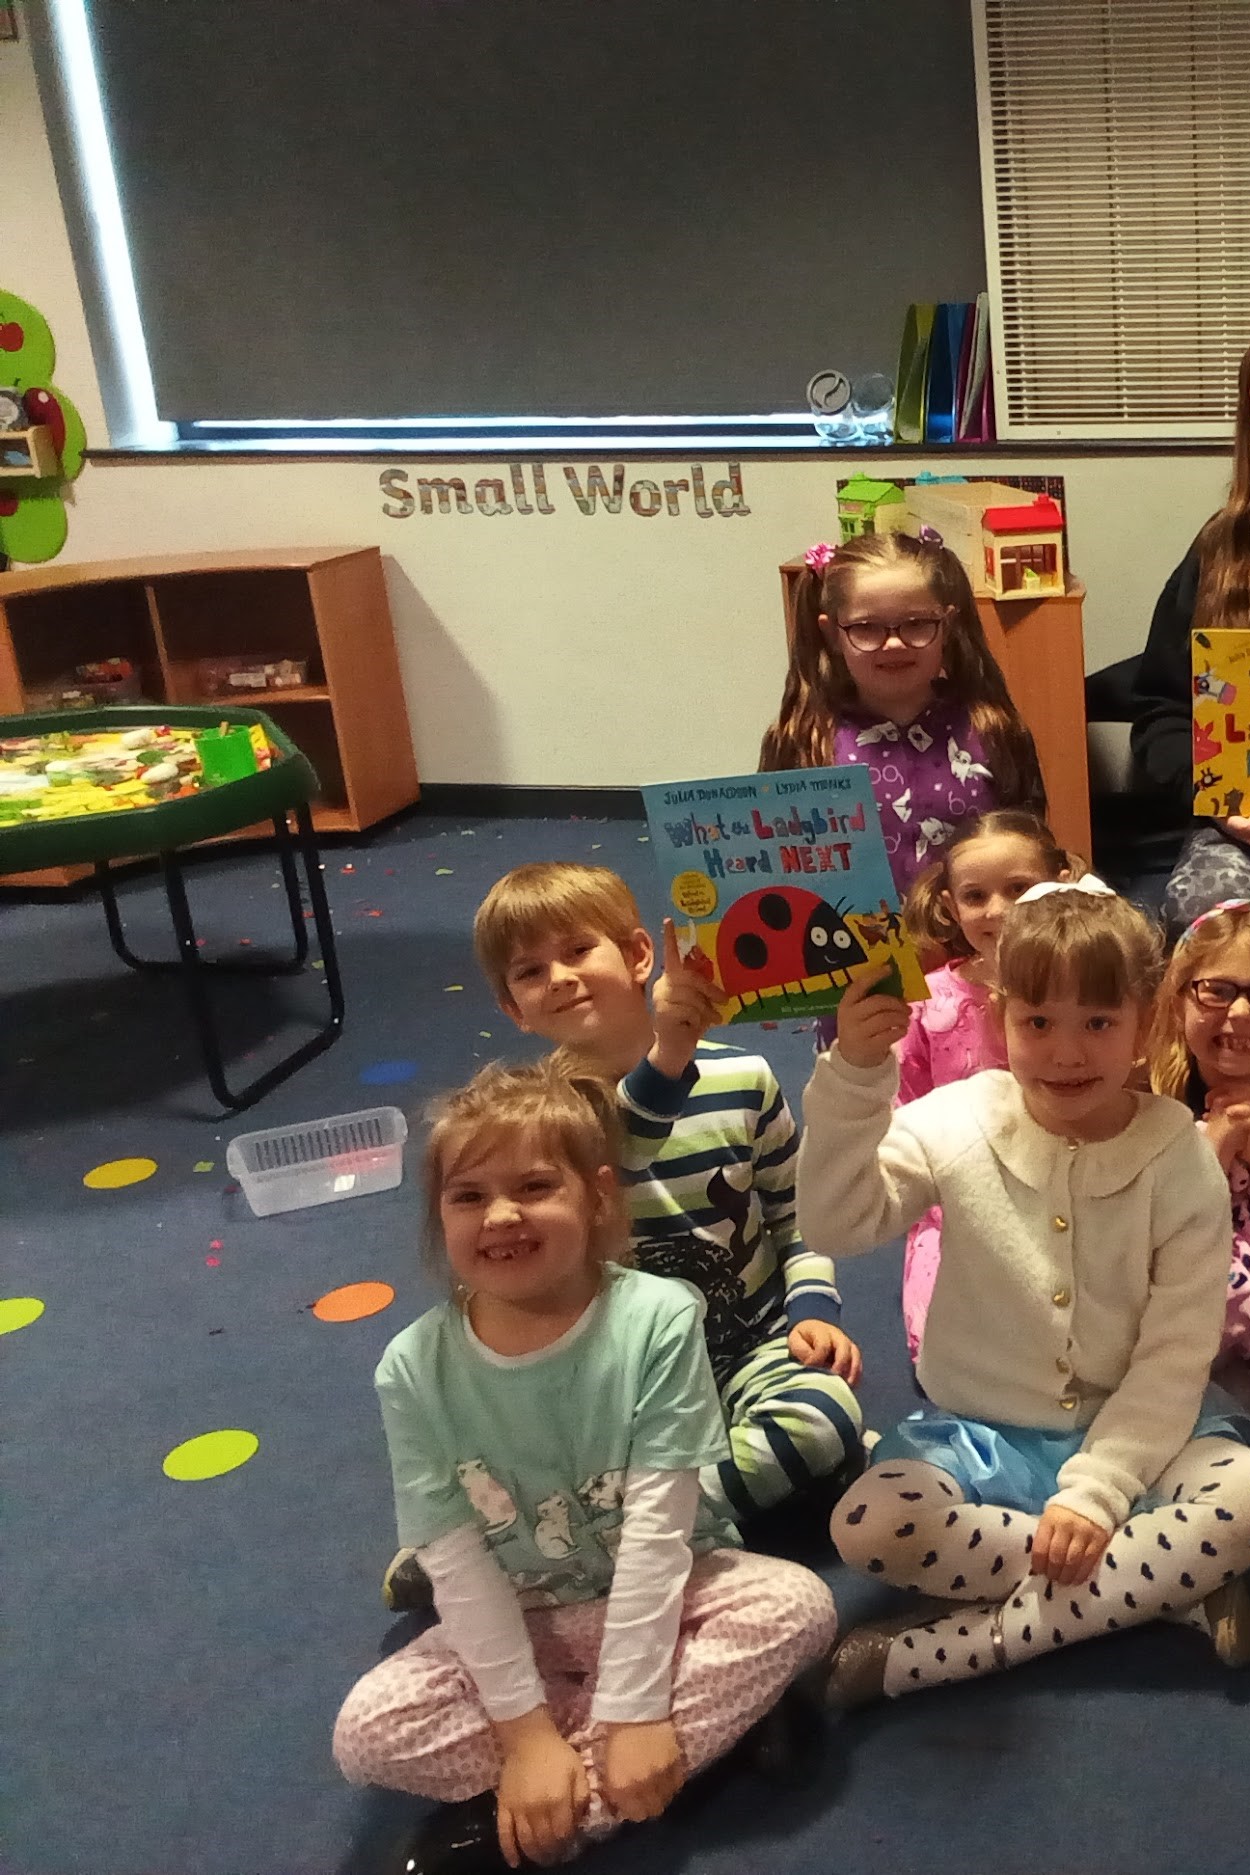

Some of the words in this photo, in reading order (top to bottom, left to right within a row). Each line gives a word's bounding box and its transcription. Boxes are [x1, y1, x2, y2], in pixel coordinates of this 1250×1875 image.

[378, 462, 556, 519] Small
[563, 462, 752, 519] World
[775, 781, 807, 796] LYDIA
[664, 811, 731, 848] What
[751, 802, 865, 845] Ladybird
[703, 848, 773, 879] Heard
[779, 842, 852, 874] NEXT
